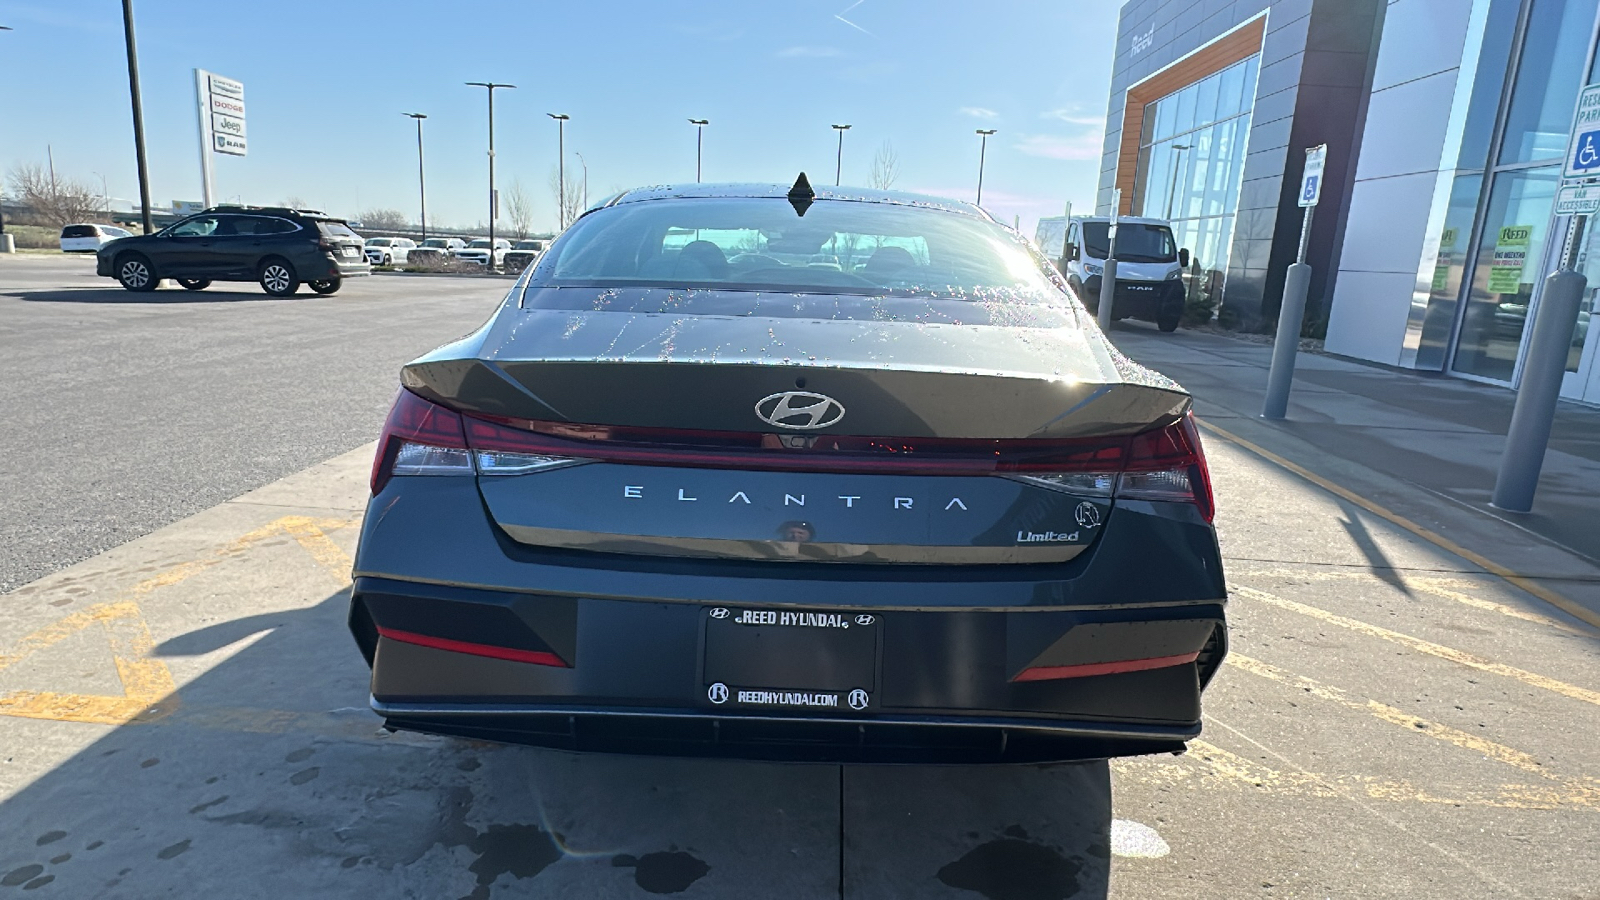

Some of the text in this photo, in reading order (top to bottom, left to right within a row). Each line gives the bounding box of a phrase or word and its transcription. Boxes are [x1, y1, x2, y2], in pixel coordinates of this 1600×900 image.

[1130, 22, 1155, 58] Reed
[214, 100, 243, 112] DODGE
[220, 118, 241, 133] Jeep
[226, 140, 246, 149] RAM
[1574, 189, 1587, 199] VAN
[1557, 199, 1598, 210] ACCESSIBLE
[1502, 227, 1528, 242] REED
[624, 485, 968, 511] ELANTRA
[1016, 530, 1080, 543] Limited
[742, 610, 842, 628] REED HYUNDAI
[737, 690, 839, 707] REEDHYUNDAI.COM
